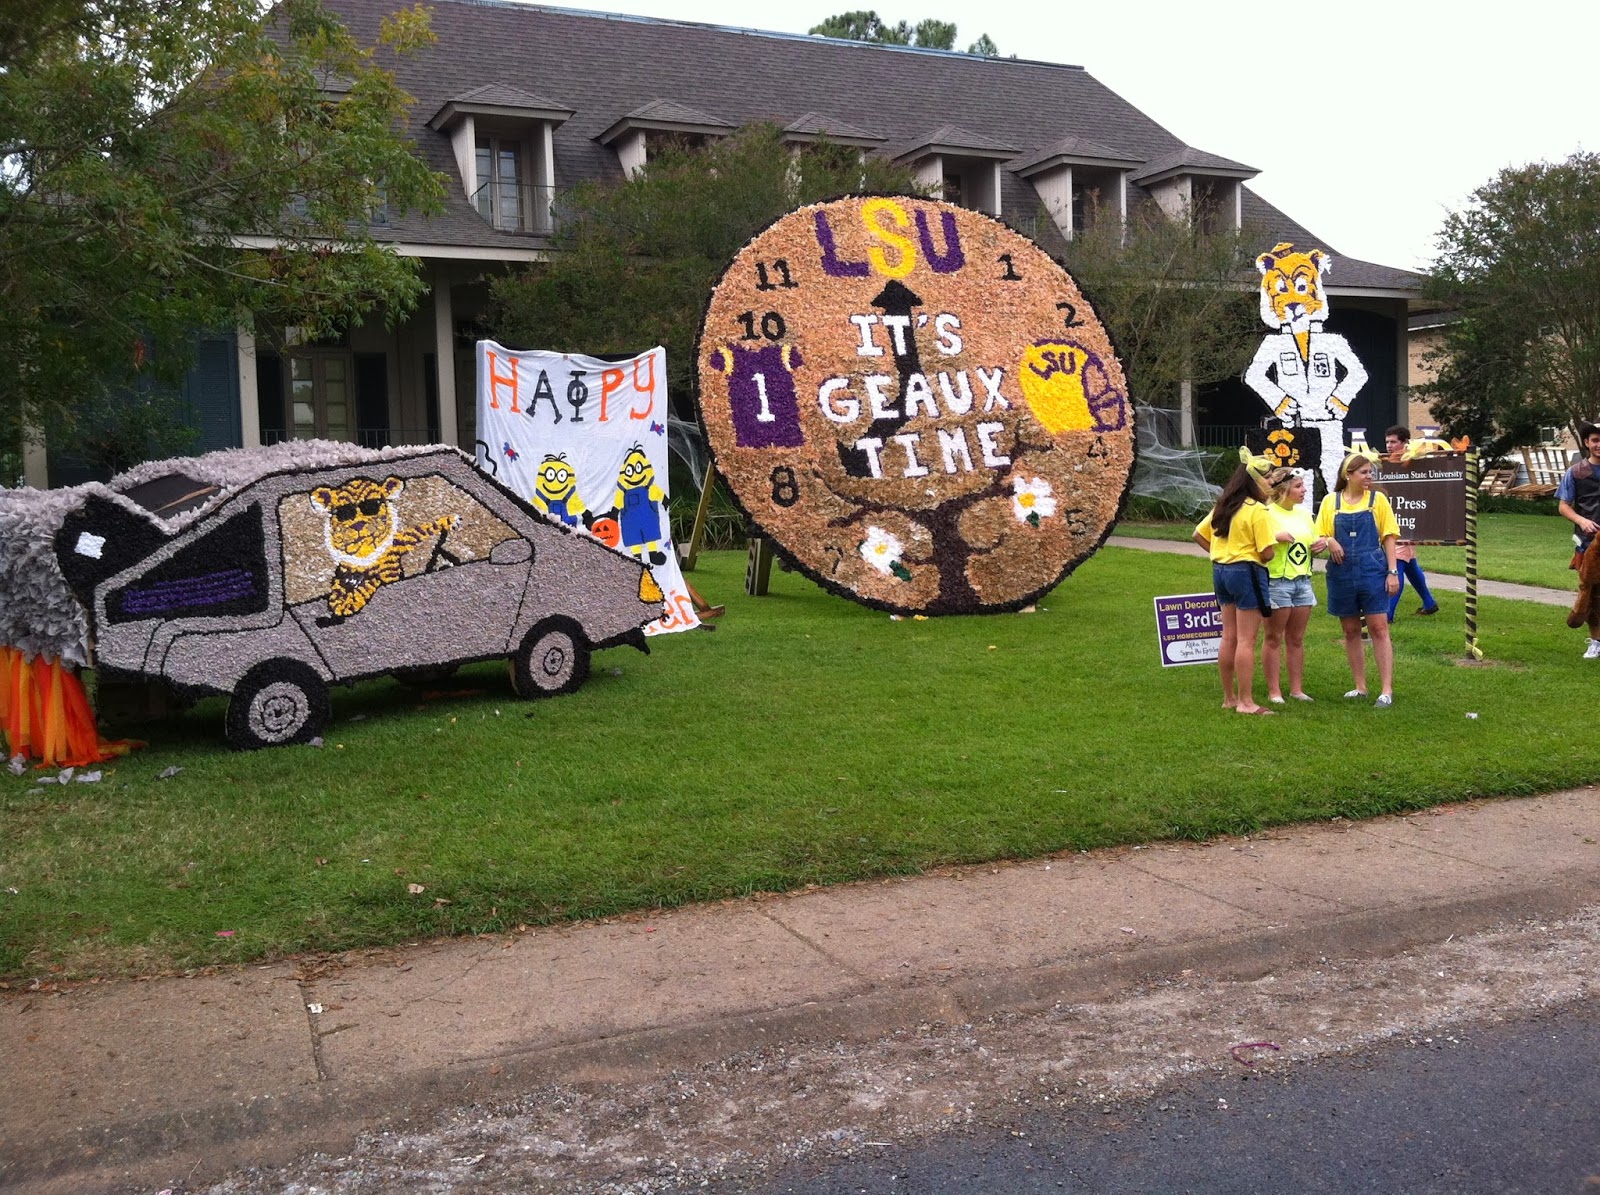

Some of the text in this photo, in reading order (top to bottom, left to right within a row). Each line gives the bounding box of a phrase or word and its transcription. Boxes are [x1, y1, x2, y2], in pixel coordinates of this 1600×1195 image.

[814, 199, 965, 278] LSU
[755, 259, 798, 291] 11
[1000, 254, 1022, 280] 1
[737, 311, 788, 341] 10
[1056, 302, 1084, 328] 2
[849, 313, 963, 356] IT'S
[1028, 351, 1077, 381] LSU
[751, 373, 776, 423] 1
[817, 366, 1011, 424] GEAUX
[856, 422, 1011, 479] TIME
[771, 466, 799, 508] 8
[1379, 469, 1463, 480] Louisiana State University
[1396, 496, 1427, 510] Press
[1159, 601, 1217, 611] Lawn Decorat
[1183, 611, 1210, 629] 3rd
